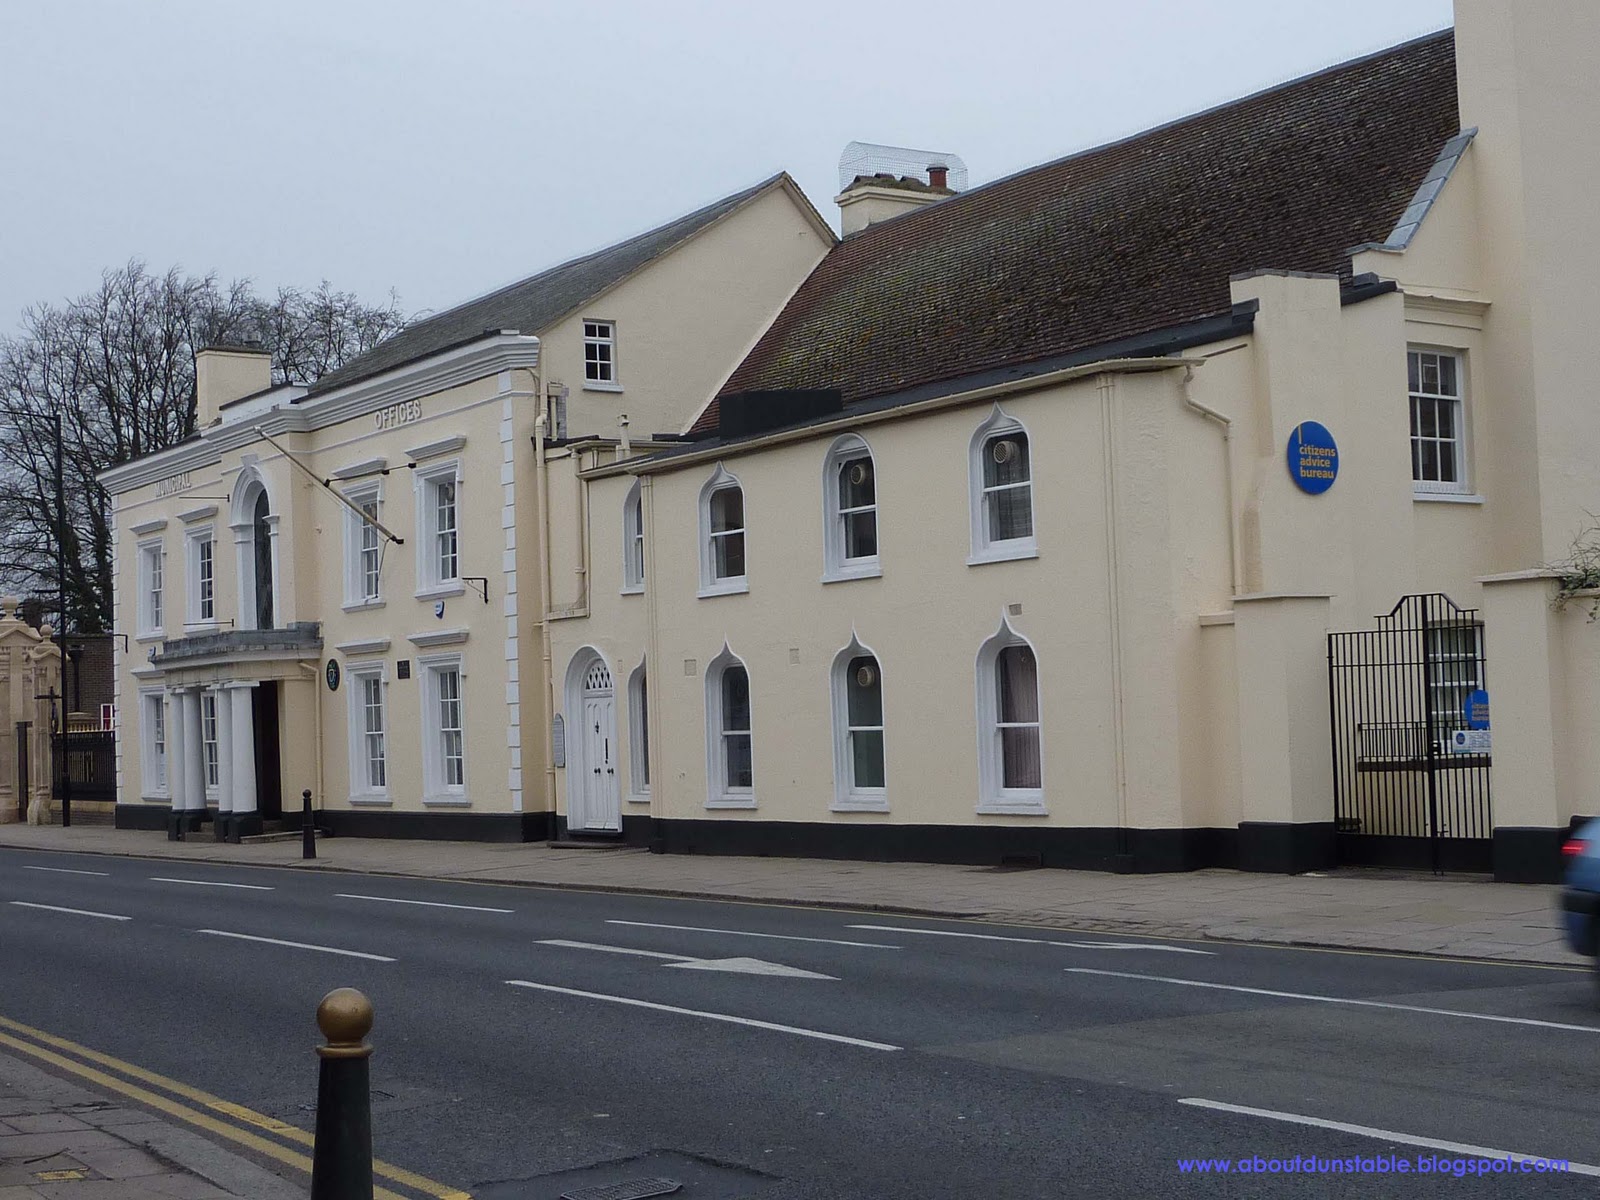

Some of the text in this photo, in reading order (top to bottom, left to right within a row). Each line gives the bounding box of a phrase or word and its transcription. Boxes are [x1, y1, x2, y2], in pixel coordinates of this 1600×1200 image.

[374, 399, 422, 430] OFFICES
[1299, 444, 1336, 457] citizens
[1300, 456, 1331, 467] advice
[1300, 466, 1335, 479] bureau
